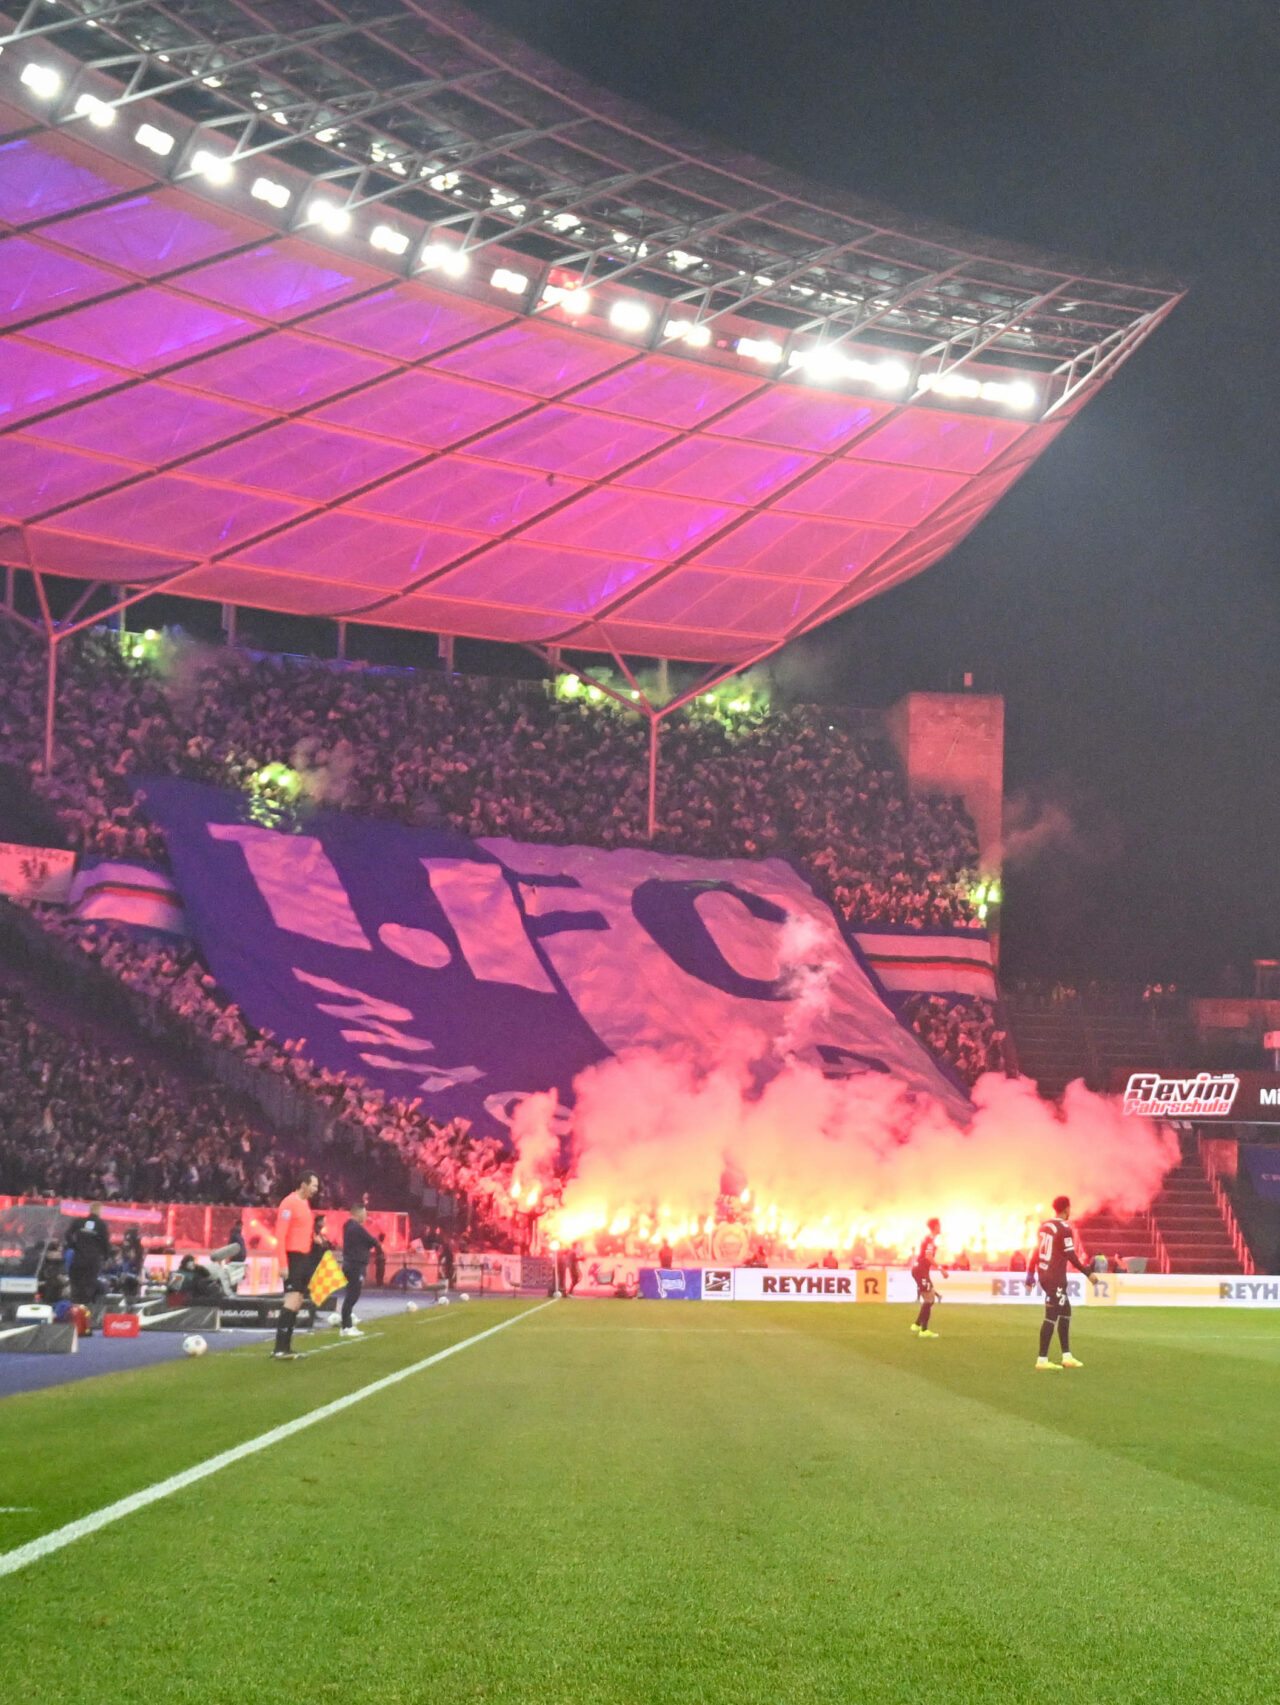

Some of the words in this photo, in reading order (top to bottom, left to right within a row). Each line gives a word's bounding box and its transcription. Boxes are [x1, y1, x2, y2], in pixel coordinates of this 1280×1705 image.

[1124, 1073, 1240, 1103] Sevim
[1123, 1097, 1233, 1116] Fahrschule
[762, 1276, 852, 1294] REYHER
